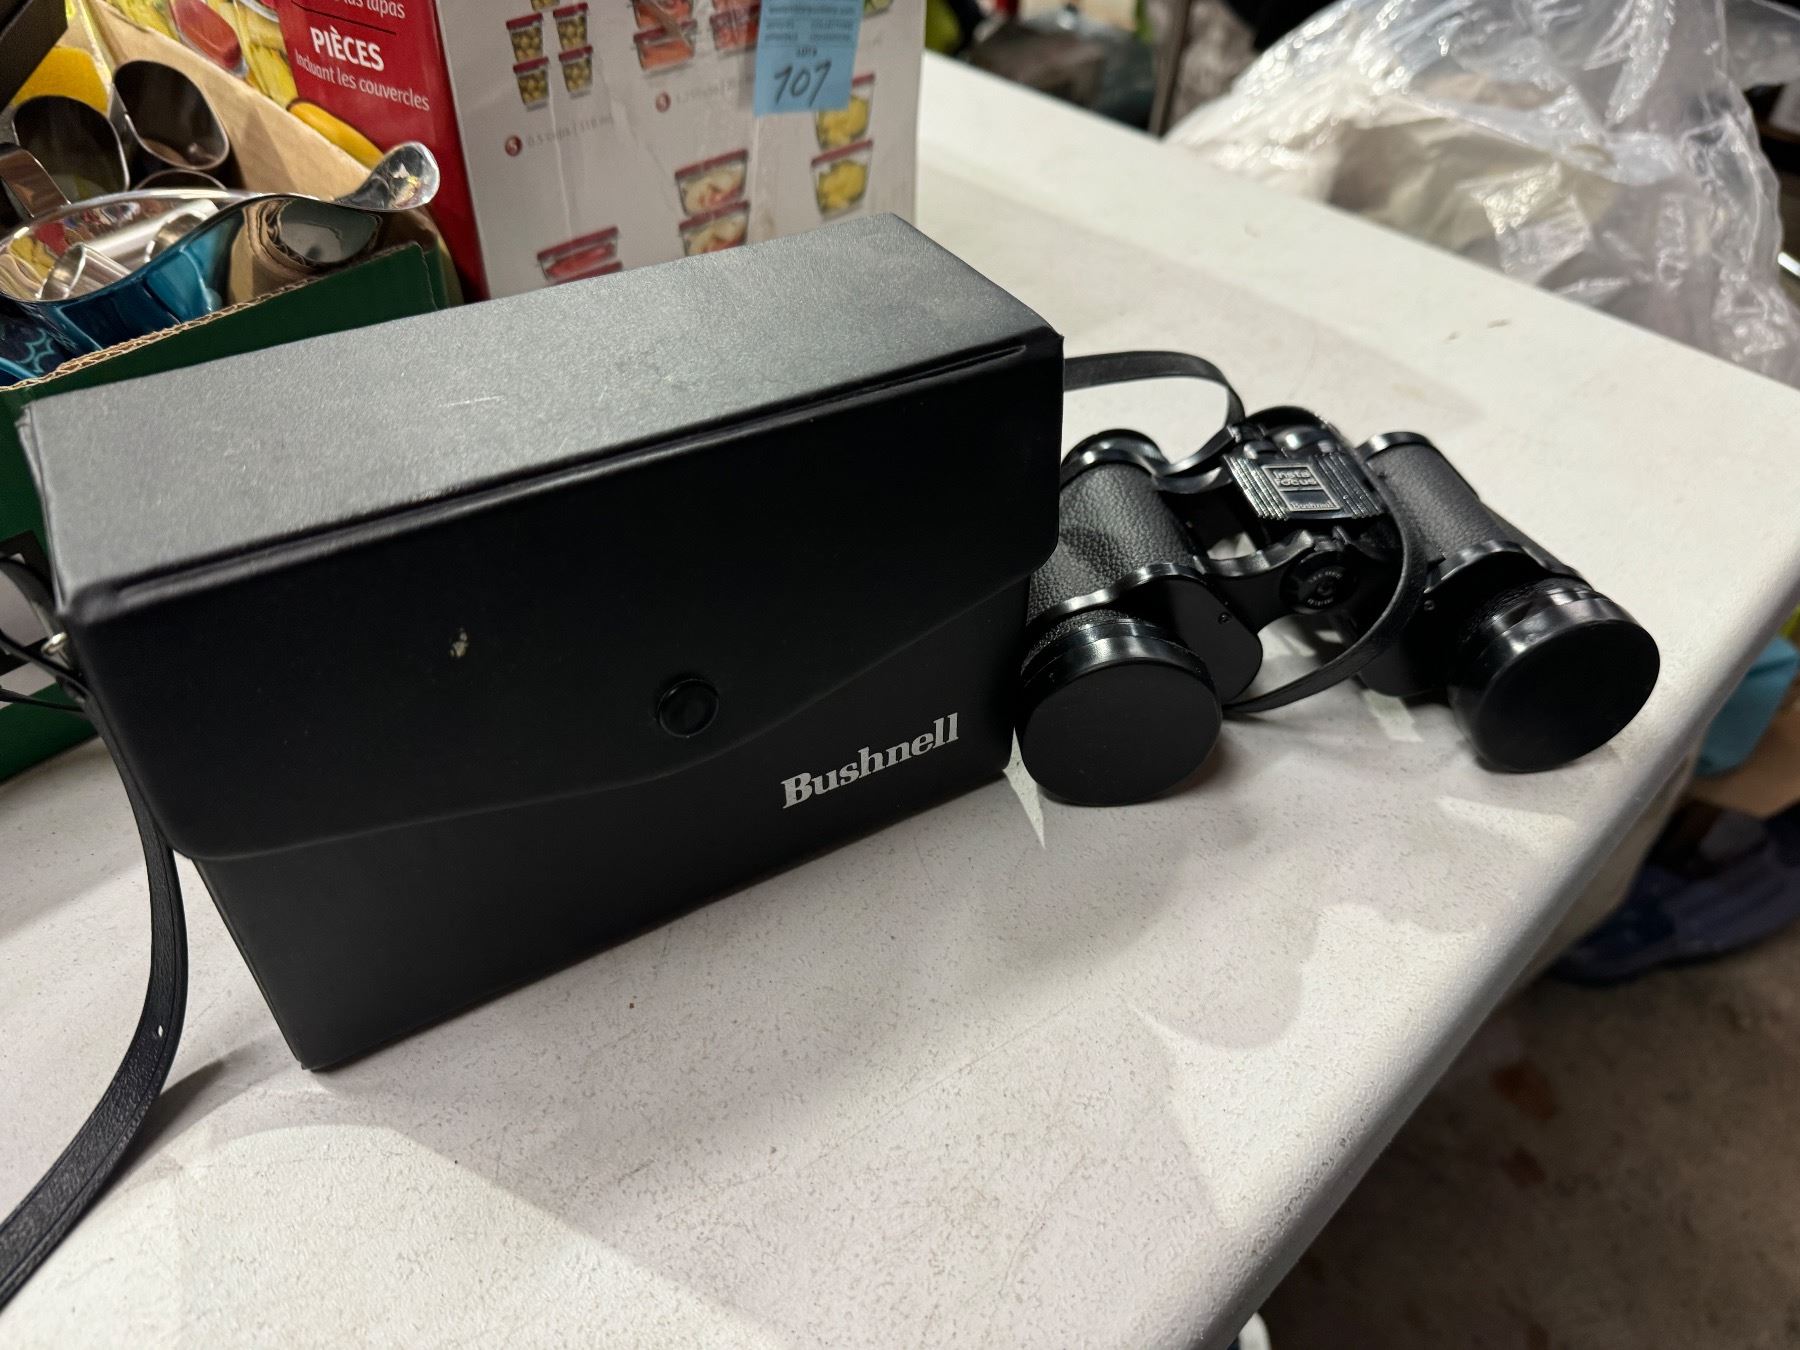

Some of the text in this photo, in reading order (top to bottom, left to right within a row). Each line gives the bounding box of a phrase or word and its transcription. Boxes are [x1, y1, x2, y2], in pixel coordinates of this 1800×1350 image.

[366, 0, 406, 19] tapas
[310, 25, 385, 72] PIÈCES
[337, 66, 357, 89] les
[359, 78, 430, 112] couvercles
[781, 712, 959, 809] Bushnell
